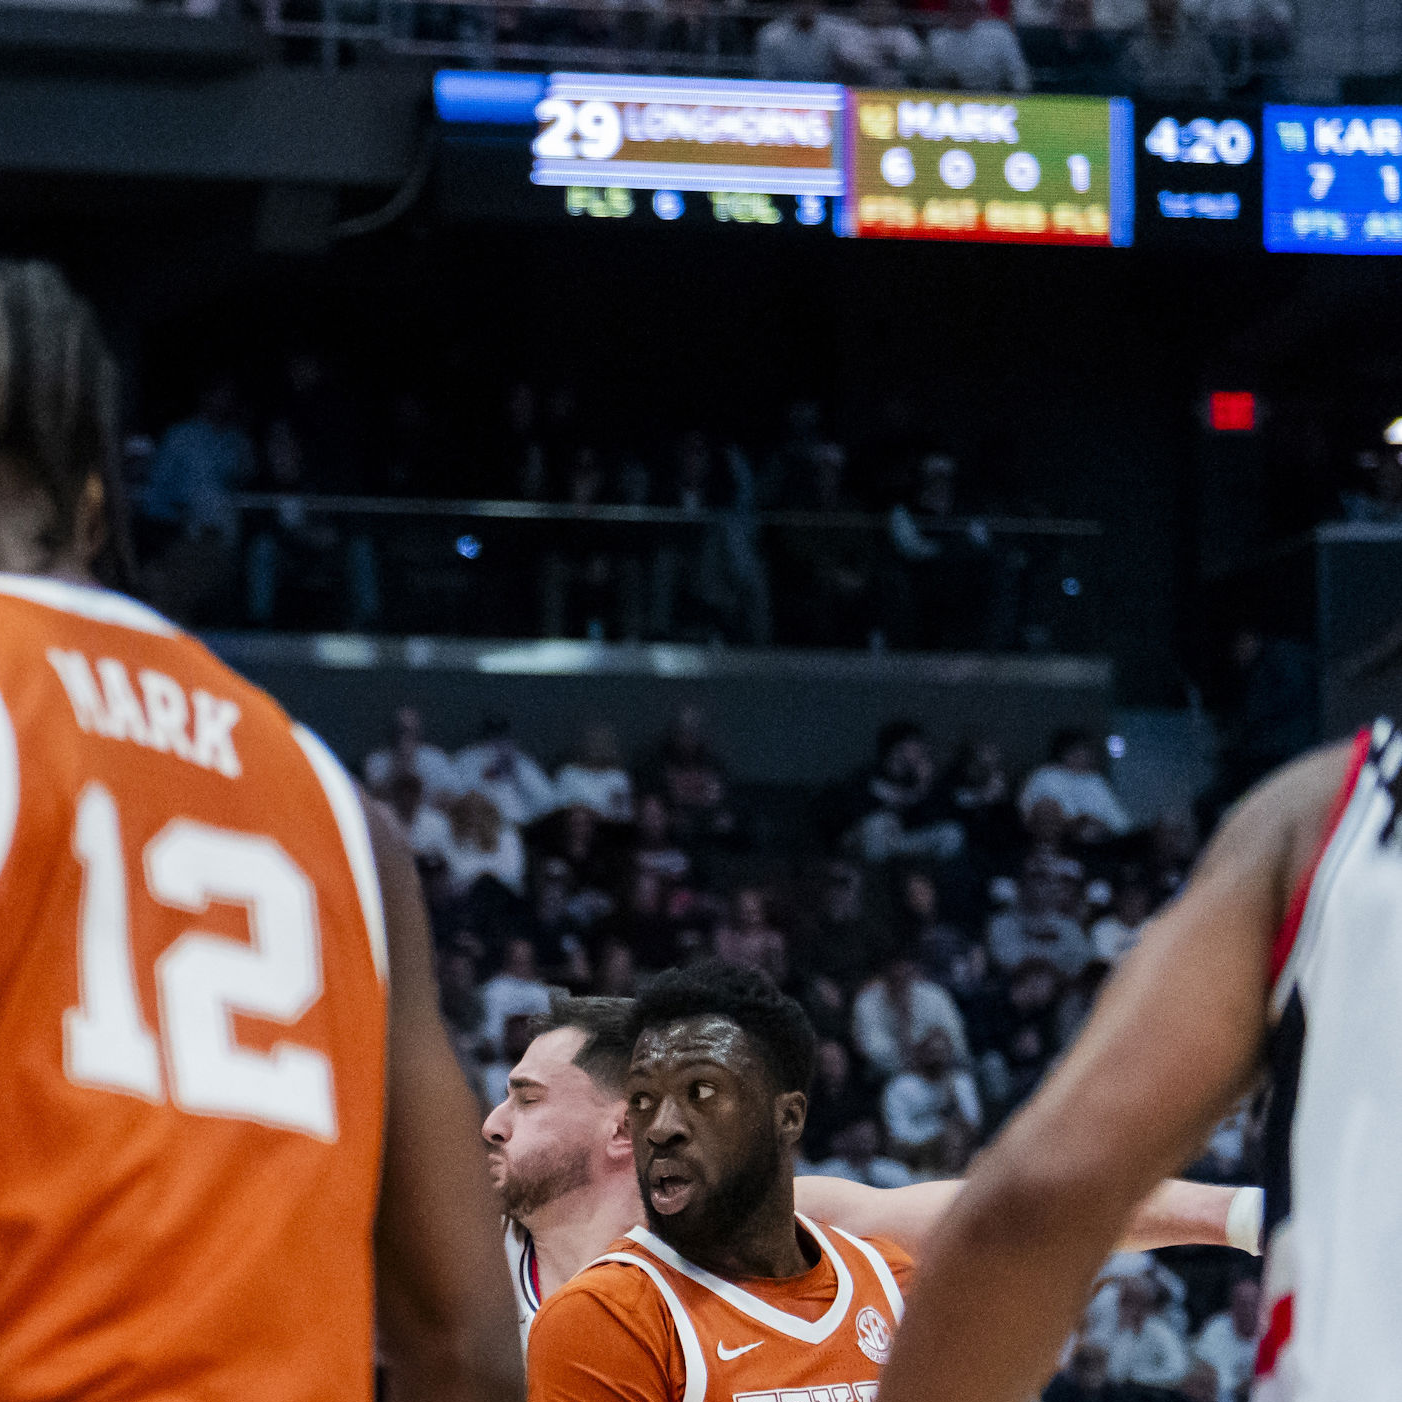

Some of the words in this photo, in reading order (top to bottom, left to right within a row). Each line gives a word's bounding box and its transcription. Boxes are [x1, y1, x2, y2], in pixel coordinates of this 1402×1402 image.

[533, 99, 623, 159] 29
[897, 101, 1019, 144] MARK
[1145, 117, 1255, 164] 4:20
[939, 149, 976, 189] 0
[1004, 151, 1041, 192] 0
[1067, 154, 1091, 193] 1
[62, 781, 338, 1143] 12
